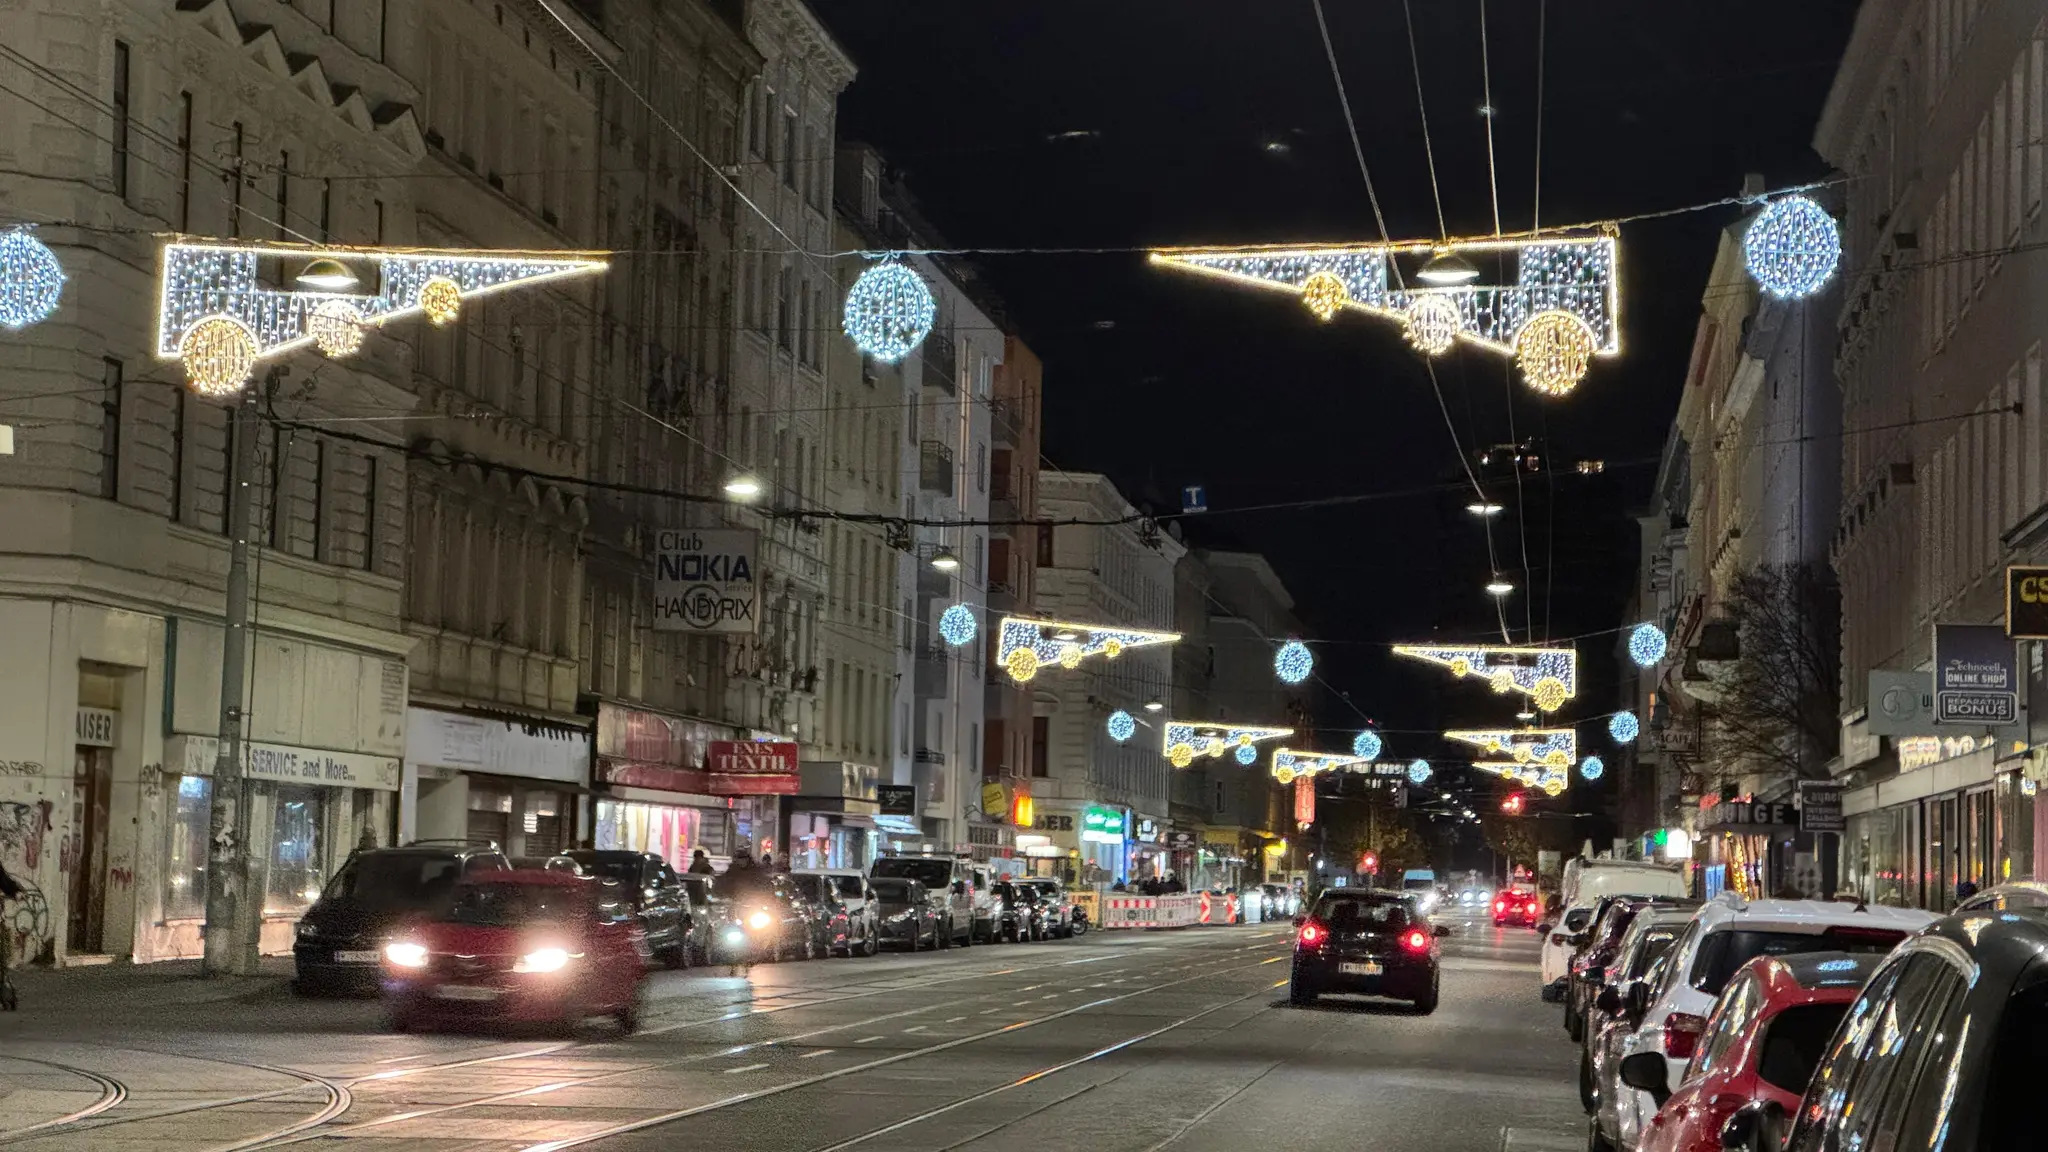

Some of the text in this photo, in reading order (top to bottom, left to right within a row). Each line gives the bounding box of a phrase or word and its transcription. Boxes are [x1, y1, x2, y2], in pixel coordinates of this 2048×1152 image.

[660, 532, 703, 551] Club
[658, 554, 753, 583] NOKIA
[654, 596, 754, 621] HANDYRIX
[1948, 673, 2006, 685] ONLINE SHOP
[1947, 697, 2006, 706] REPARATUR
[1947, 704, 2007, 715] BONUS
[251, 749, 297, 776] SERVICE
[302, 756, 321, 778] and
[717, 755, 792, 770] TEXTIL
